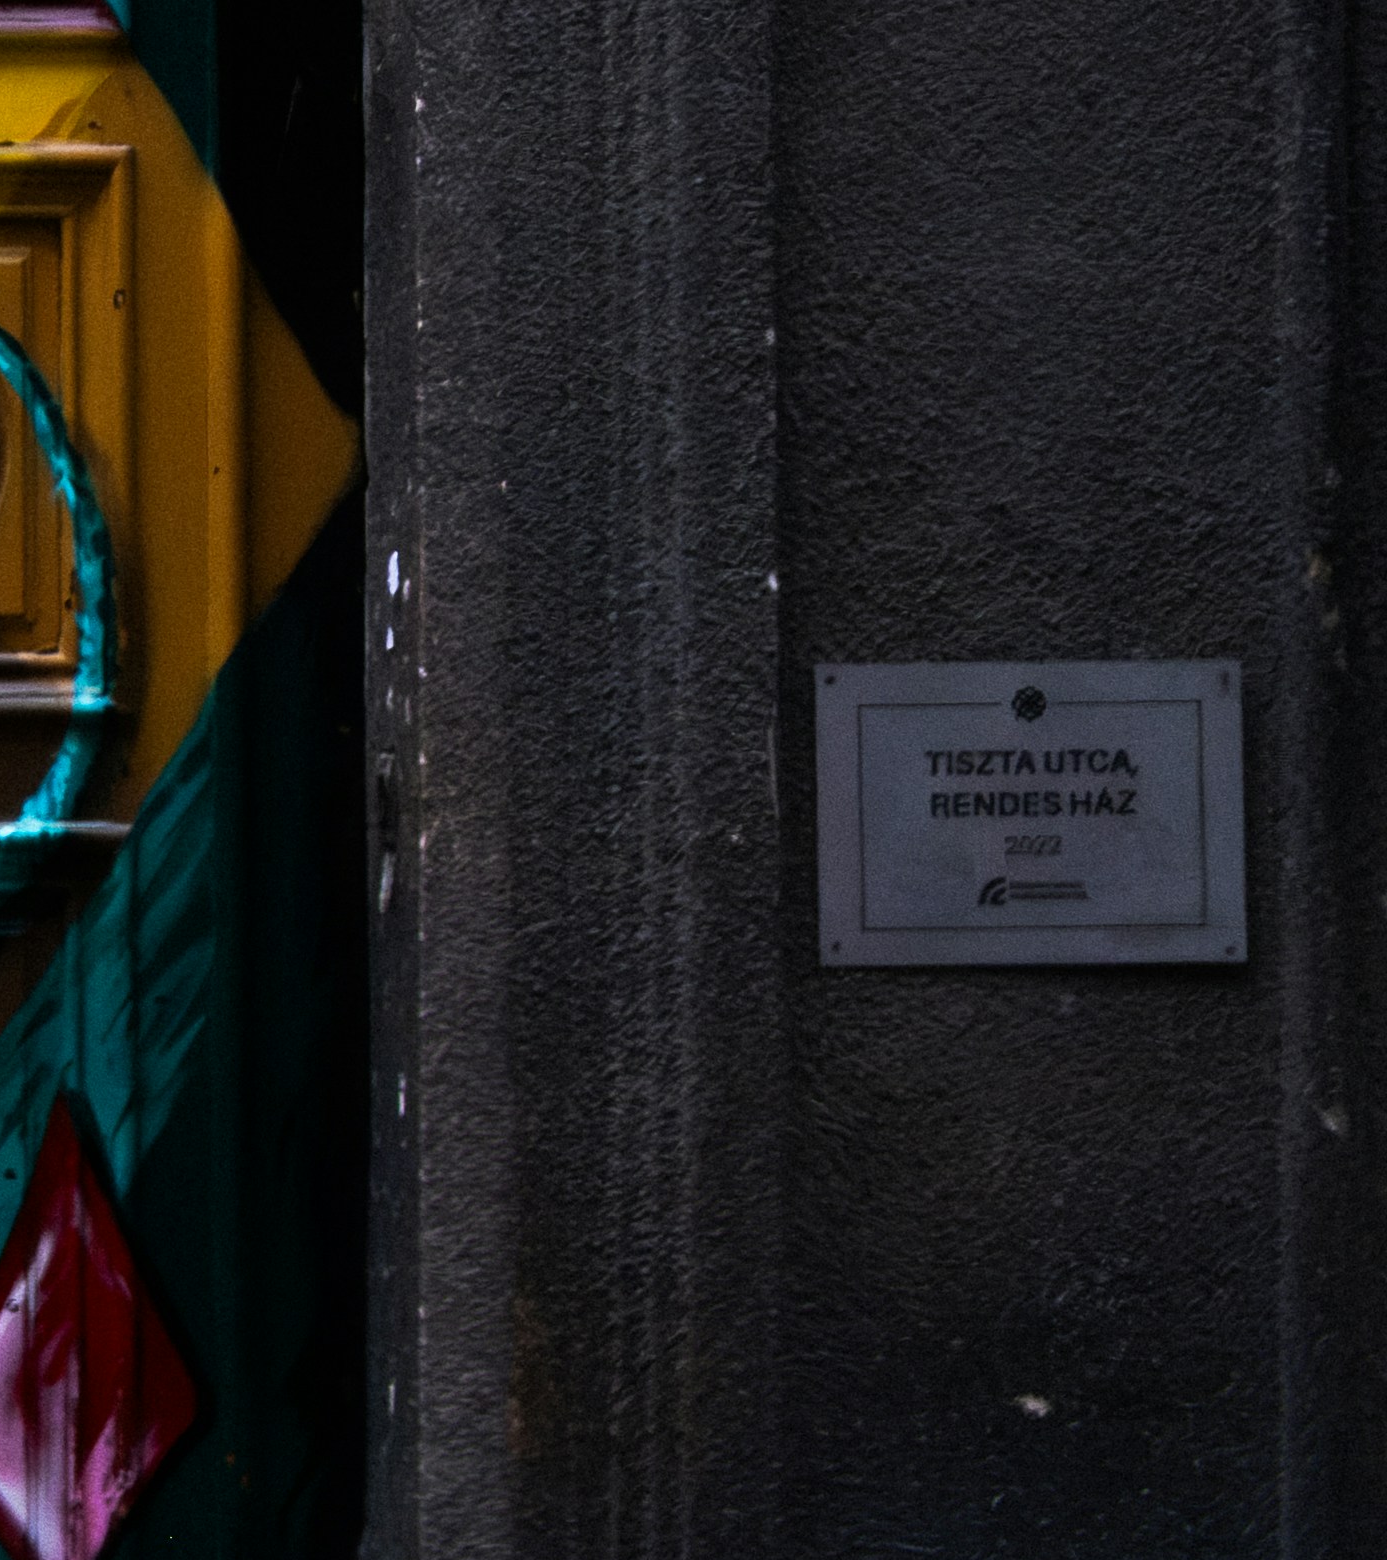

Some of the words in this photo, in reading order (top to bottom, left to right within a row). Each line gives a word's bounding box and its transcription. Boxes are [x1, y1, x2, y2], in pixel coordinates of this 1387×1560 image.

[926, 749, 1036, 778] TISZTA
[1044, 748, 1138, 779] UTCA,
[930, 791, 1062, 819] RENDES
[1071, 787, 1137, 817] HÁZ
